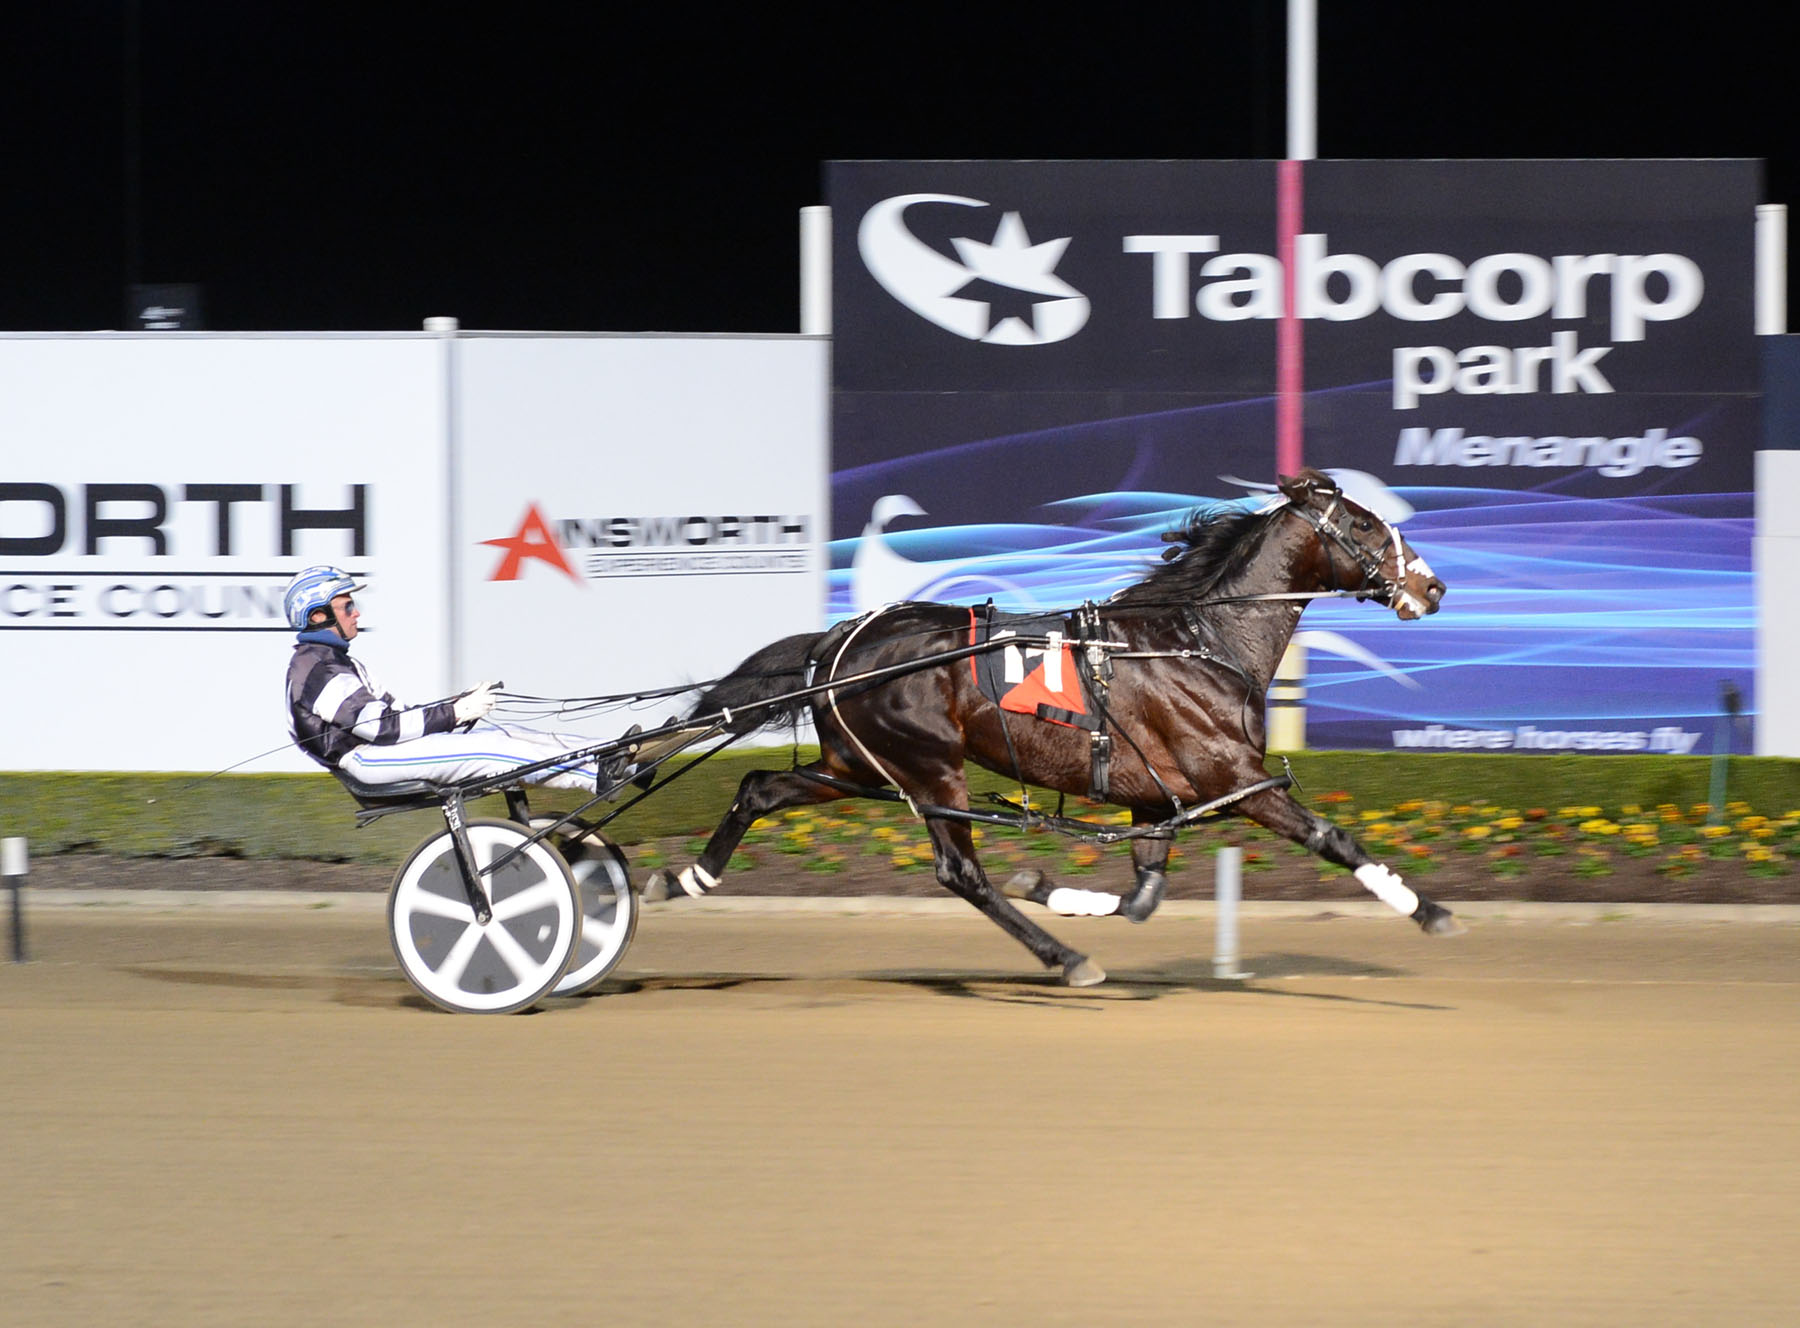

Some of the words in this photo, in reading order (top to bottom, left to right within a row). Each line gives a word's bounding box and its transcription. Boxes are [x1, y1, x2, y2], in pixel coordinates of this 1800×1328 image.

[1124, 233, 1705, 343] Tabcorp
[1392, 330, 1615, 411] park
[1394, 426, 1703, 479] Menangle
[477, 500, 810, 582] AINSWORTH
[99, 583, 287, 619] COUN
[1392, 724, 1514, 750] where
[1515, 725, 1646, 752] horses
[1648, 726, 1702, 755] fly
